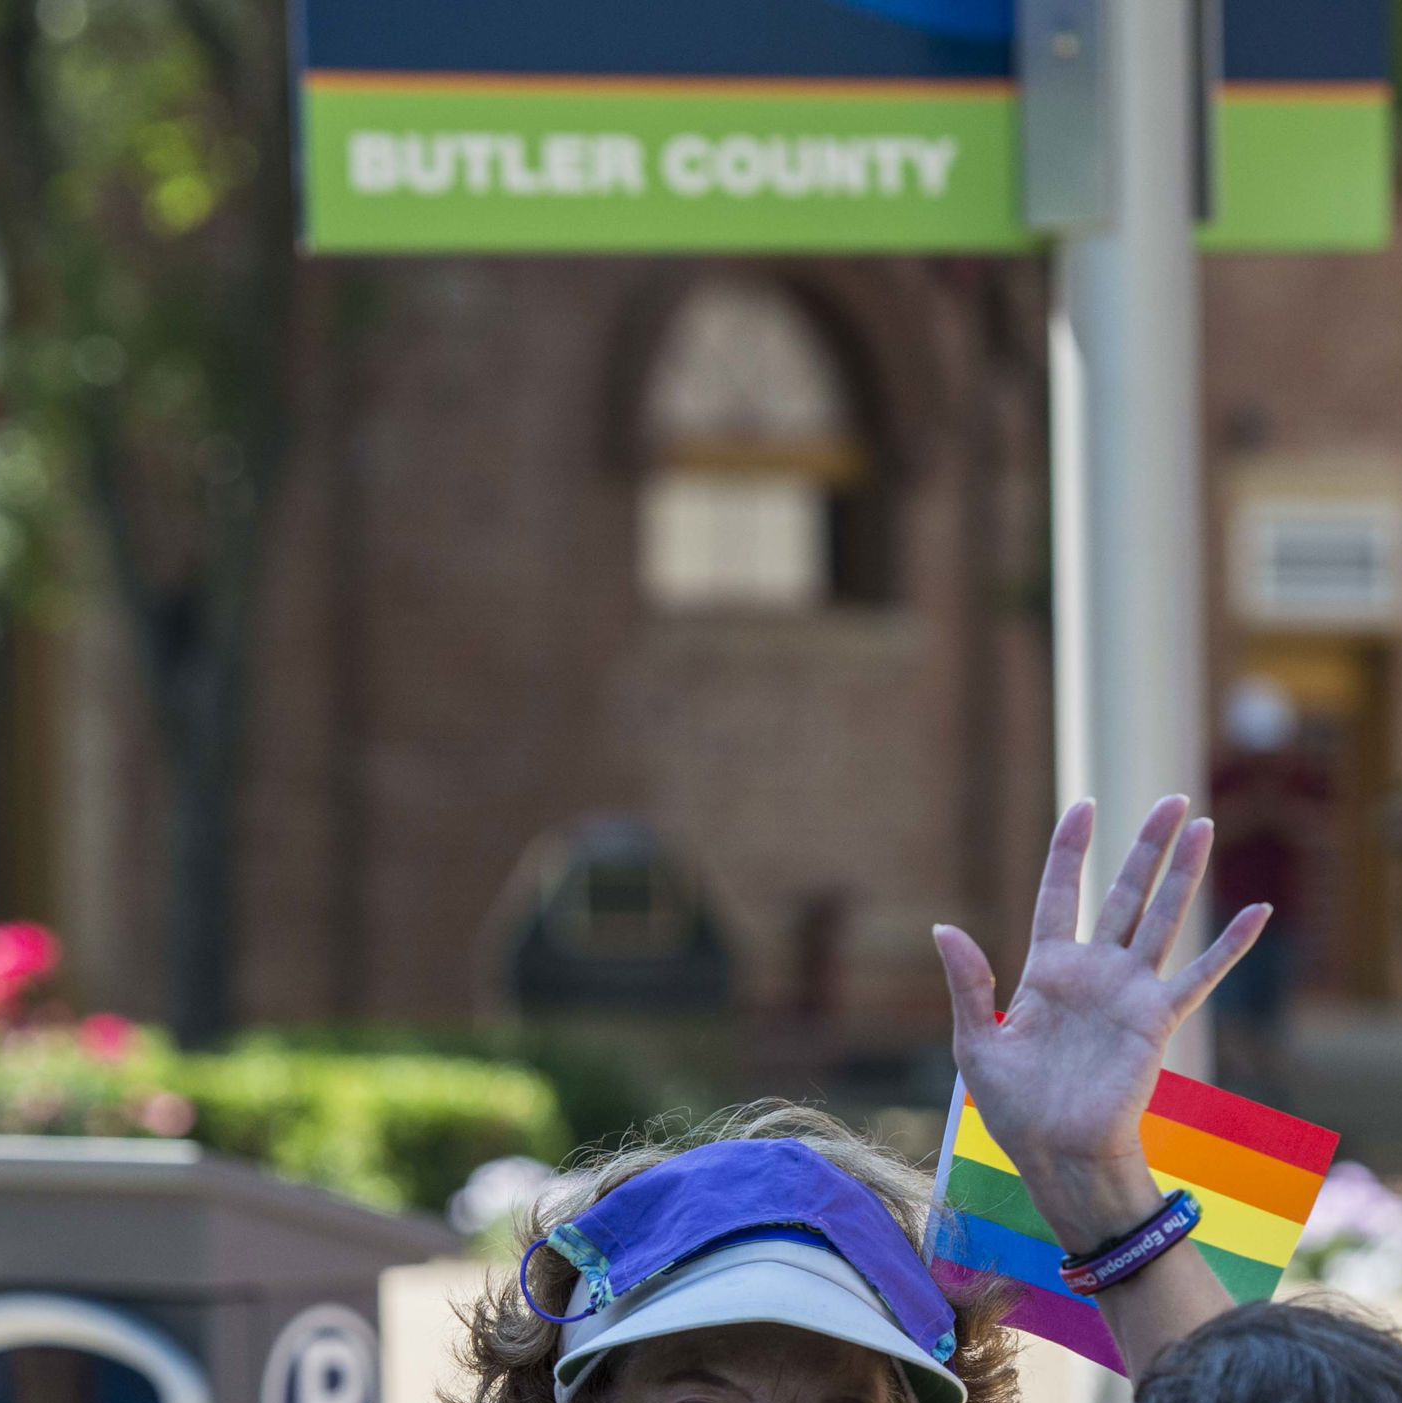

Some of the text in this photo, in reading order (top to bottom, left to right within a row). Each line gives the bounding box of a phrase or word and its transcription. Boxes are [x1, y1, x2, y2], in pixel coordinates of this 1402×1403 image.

[346, 133, 956, 197] BUTLER COUNTY
[1162, 1211, 1190, 1234] The
[1096, 1230, 1166, 1281] Episcopal
